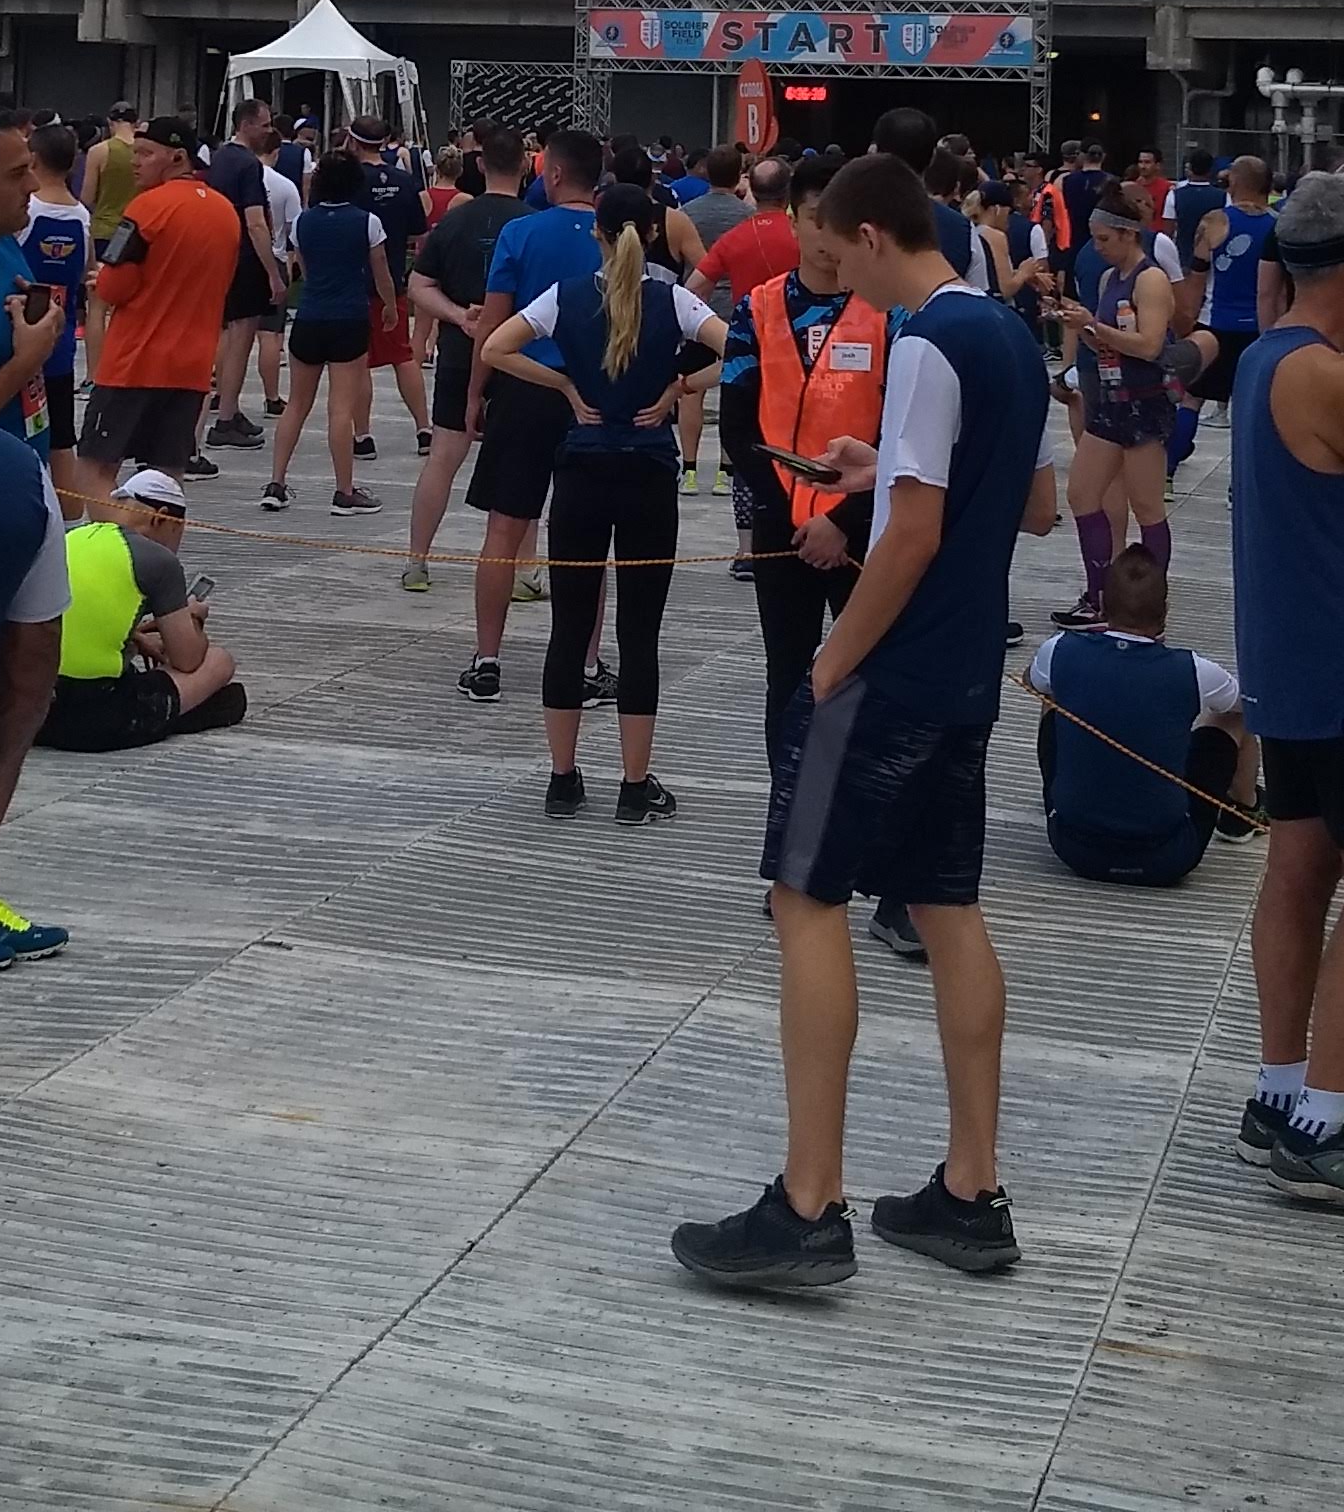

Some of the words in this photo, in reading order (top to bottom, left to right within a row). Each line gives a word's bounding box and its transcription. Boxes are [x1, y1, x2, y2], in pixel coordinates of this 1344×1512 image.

[664, 20, 709, 30] SOLDIER
[672, 29, 702, 39] FIELD
[720, 20, 890, 54] START
[747, 103, 760, 144] B
